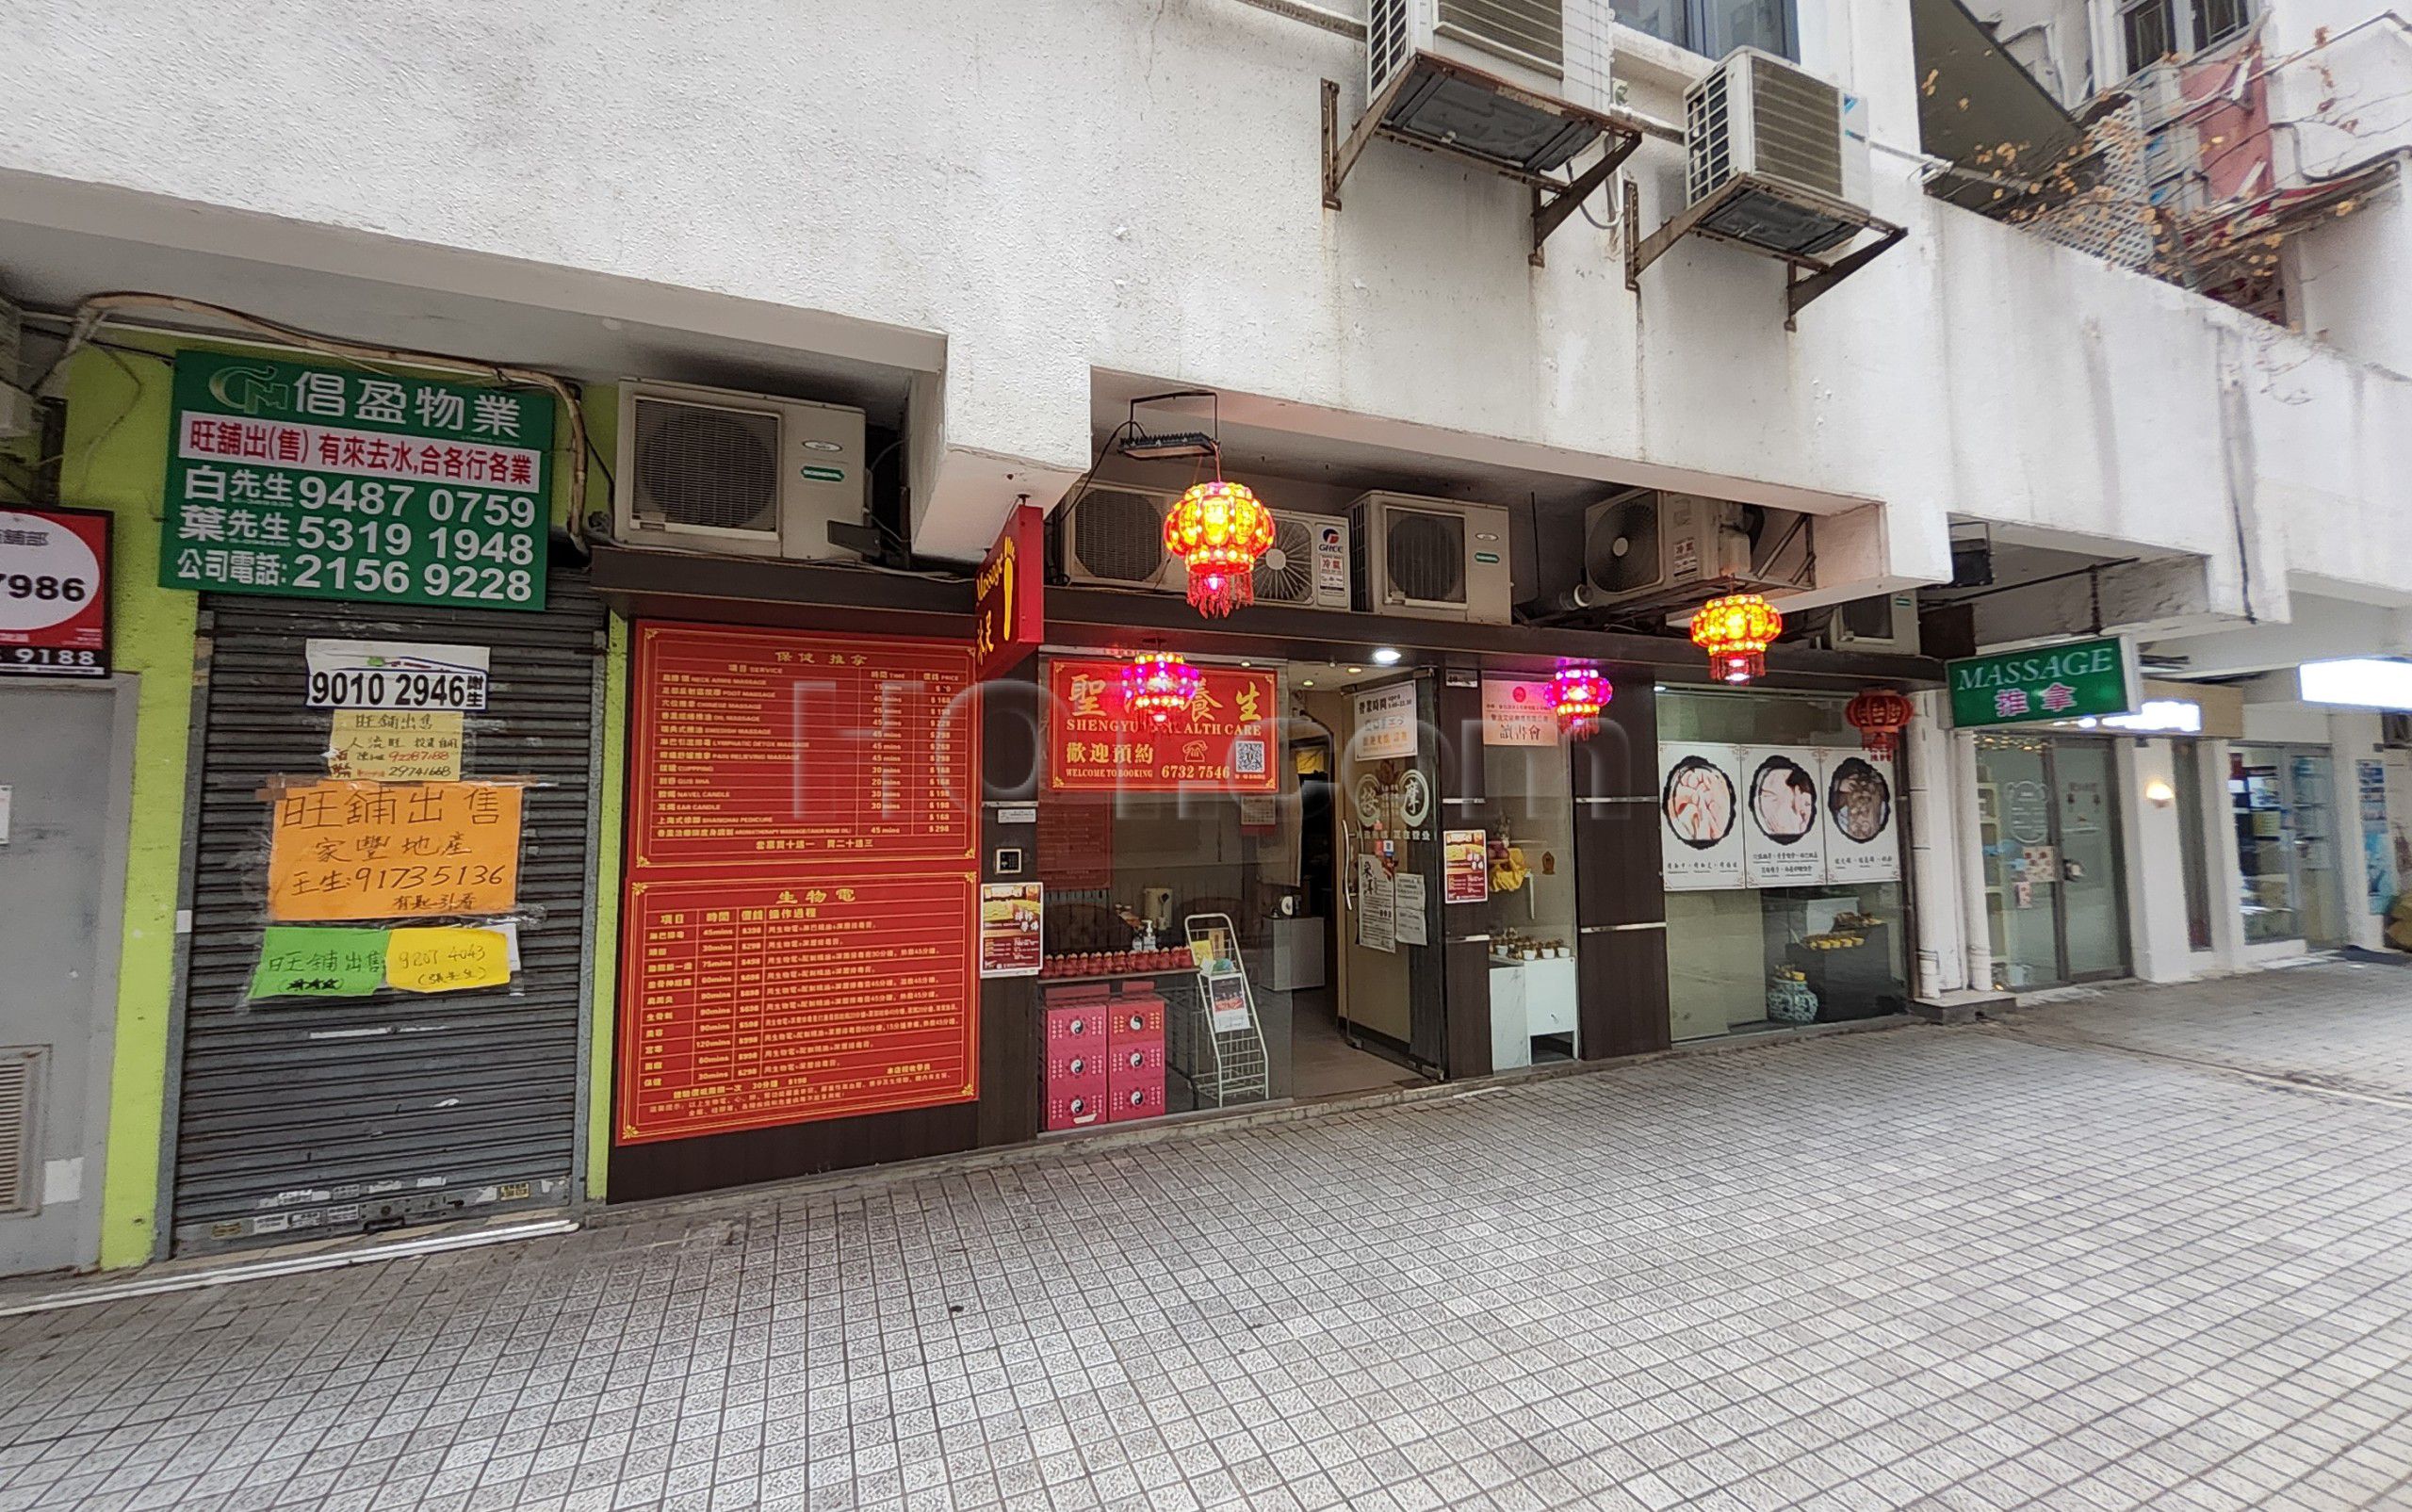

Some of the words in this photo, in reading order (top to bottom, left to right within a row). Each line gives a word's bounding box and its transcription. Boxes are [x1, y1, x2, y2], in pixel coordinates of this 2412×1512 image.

[294, 370, 522, 438] 倡盈物業
[184, 465, 293, 502] 白先生
[299, 478, 415, 516] 9487
[428, 488, 535, 528] 0759
[179, 503, 291, 543] 葉先生
[296, 515, 412, 555] 5319
[427, 527, 534, 565] 1948
[292, 554, 410, 593] 2156
[423, 564, 532, 602] 9228
[1957, 647, 2113, 691] MASSAGE
[312, 672, 384, 705] 9010
[394, 674, 464, 707] 2946
[1994, 682, 2078, 718] 推拿
[1224, 723, 1263, 737] CARE
[1066, 742, 1154, 765] 歡迎預約
[1066, 768, 1105, 778] WELCOME
[1106, 769, 1116, 778] TO
[1117, 769, 1153, 778] BOOKING
[1161, 765, 1195, 779] 6732
[1198, 766, 1230, 779] 7546
[354, 864, 506, 893] 91735136
[774, 888, 856, 905] 生物電
